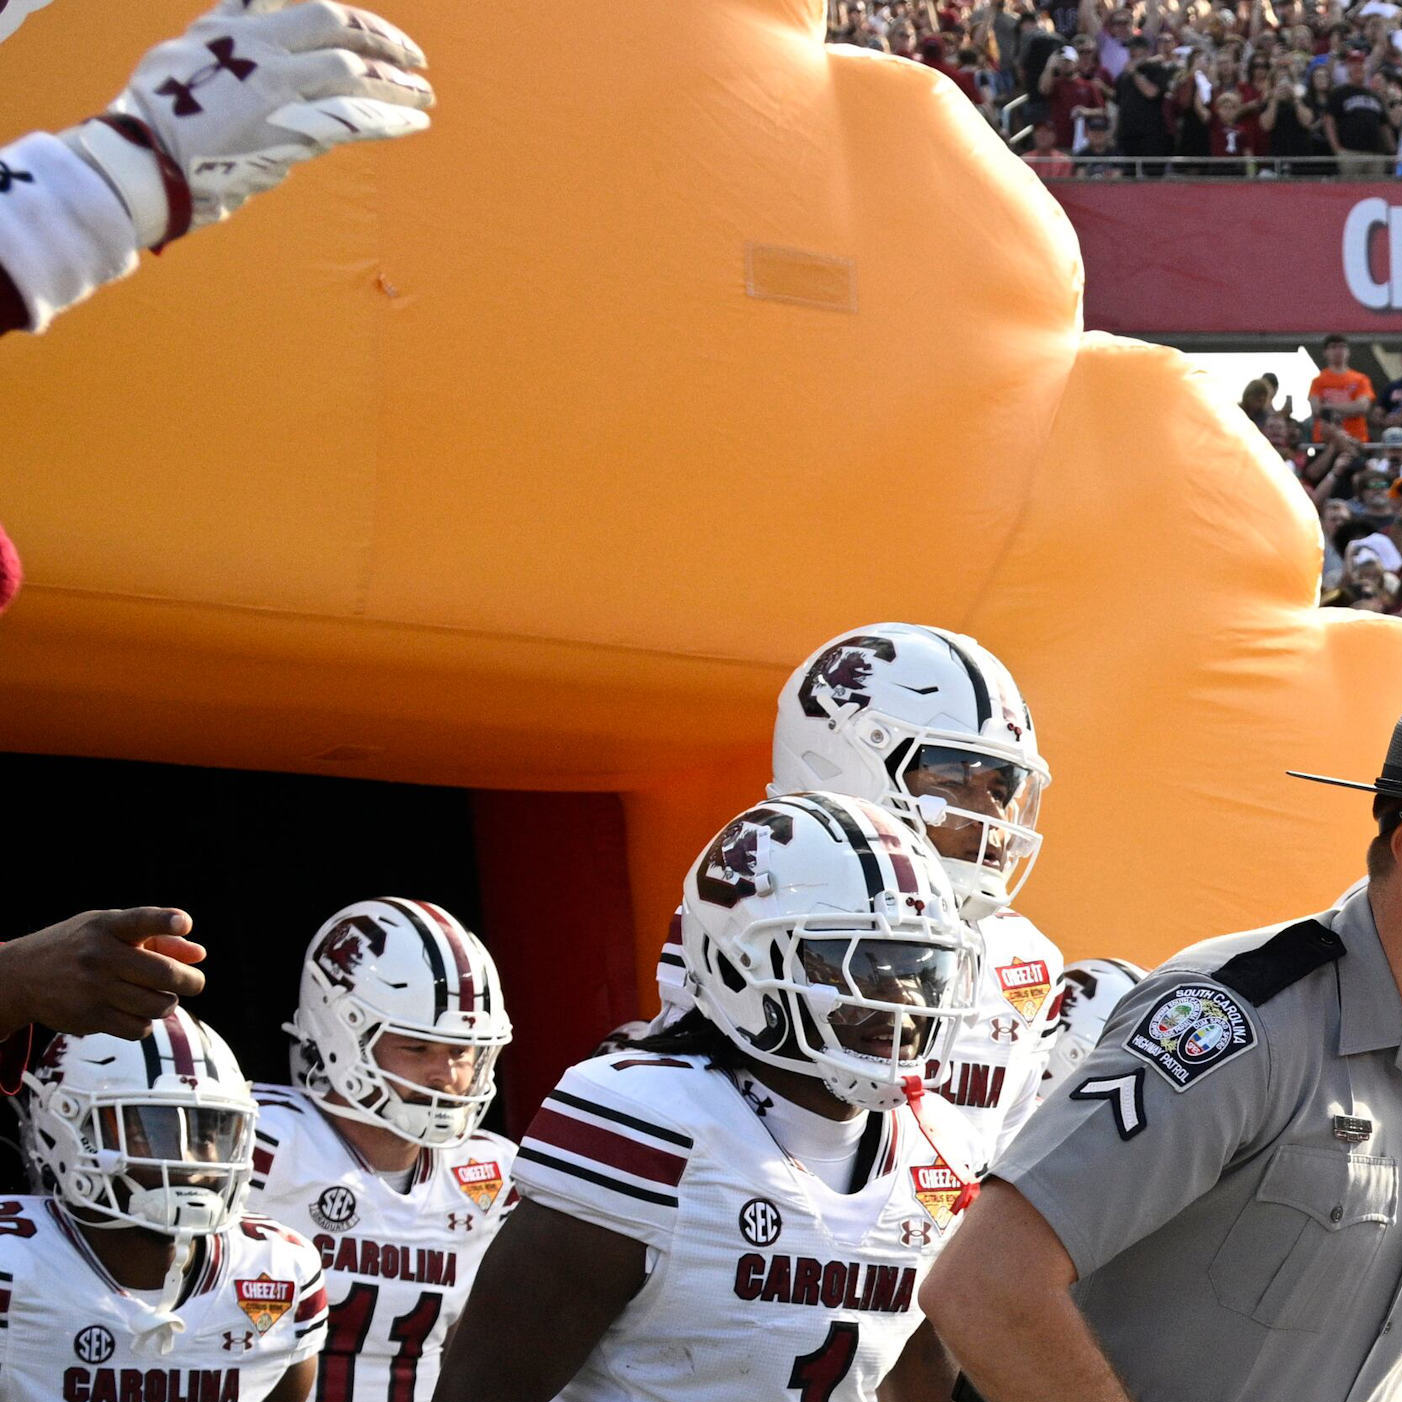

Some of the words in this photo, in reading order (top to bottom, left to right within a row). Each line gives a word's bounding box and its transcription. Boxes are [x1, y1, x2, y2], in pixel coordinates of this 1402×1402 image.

[1176, 989, 1215, 1000] SOUTH
[1213, 993, 1247, 1044] CAROLINA
[924, 1058, 1006, 1109] OLINA
[1132, 1034, 1166, 1057] HIGHWAY
[1160, 1052, 1191, 1084] PATROL
[320, 1188, 352, 1221] SEC
[742, 1203, 780, 1243] SEC
[313, 1233, 457, 1288] CAROLINA
[734, 1253, 917, 1313] CAROLINA
[77, 1328, 113, 1362] SEC
